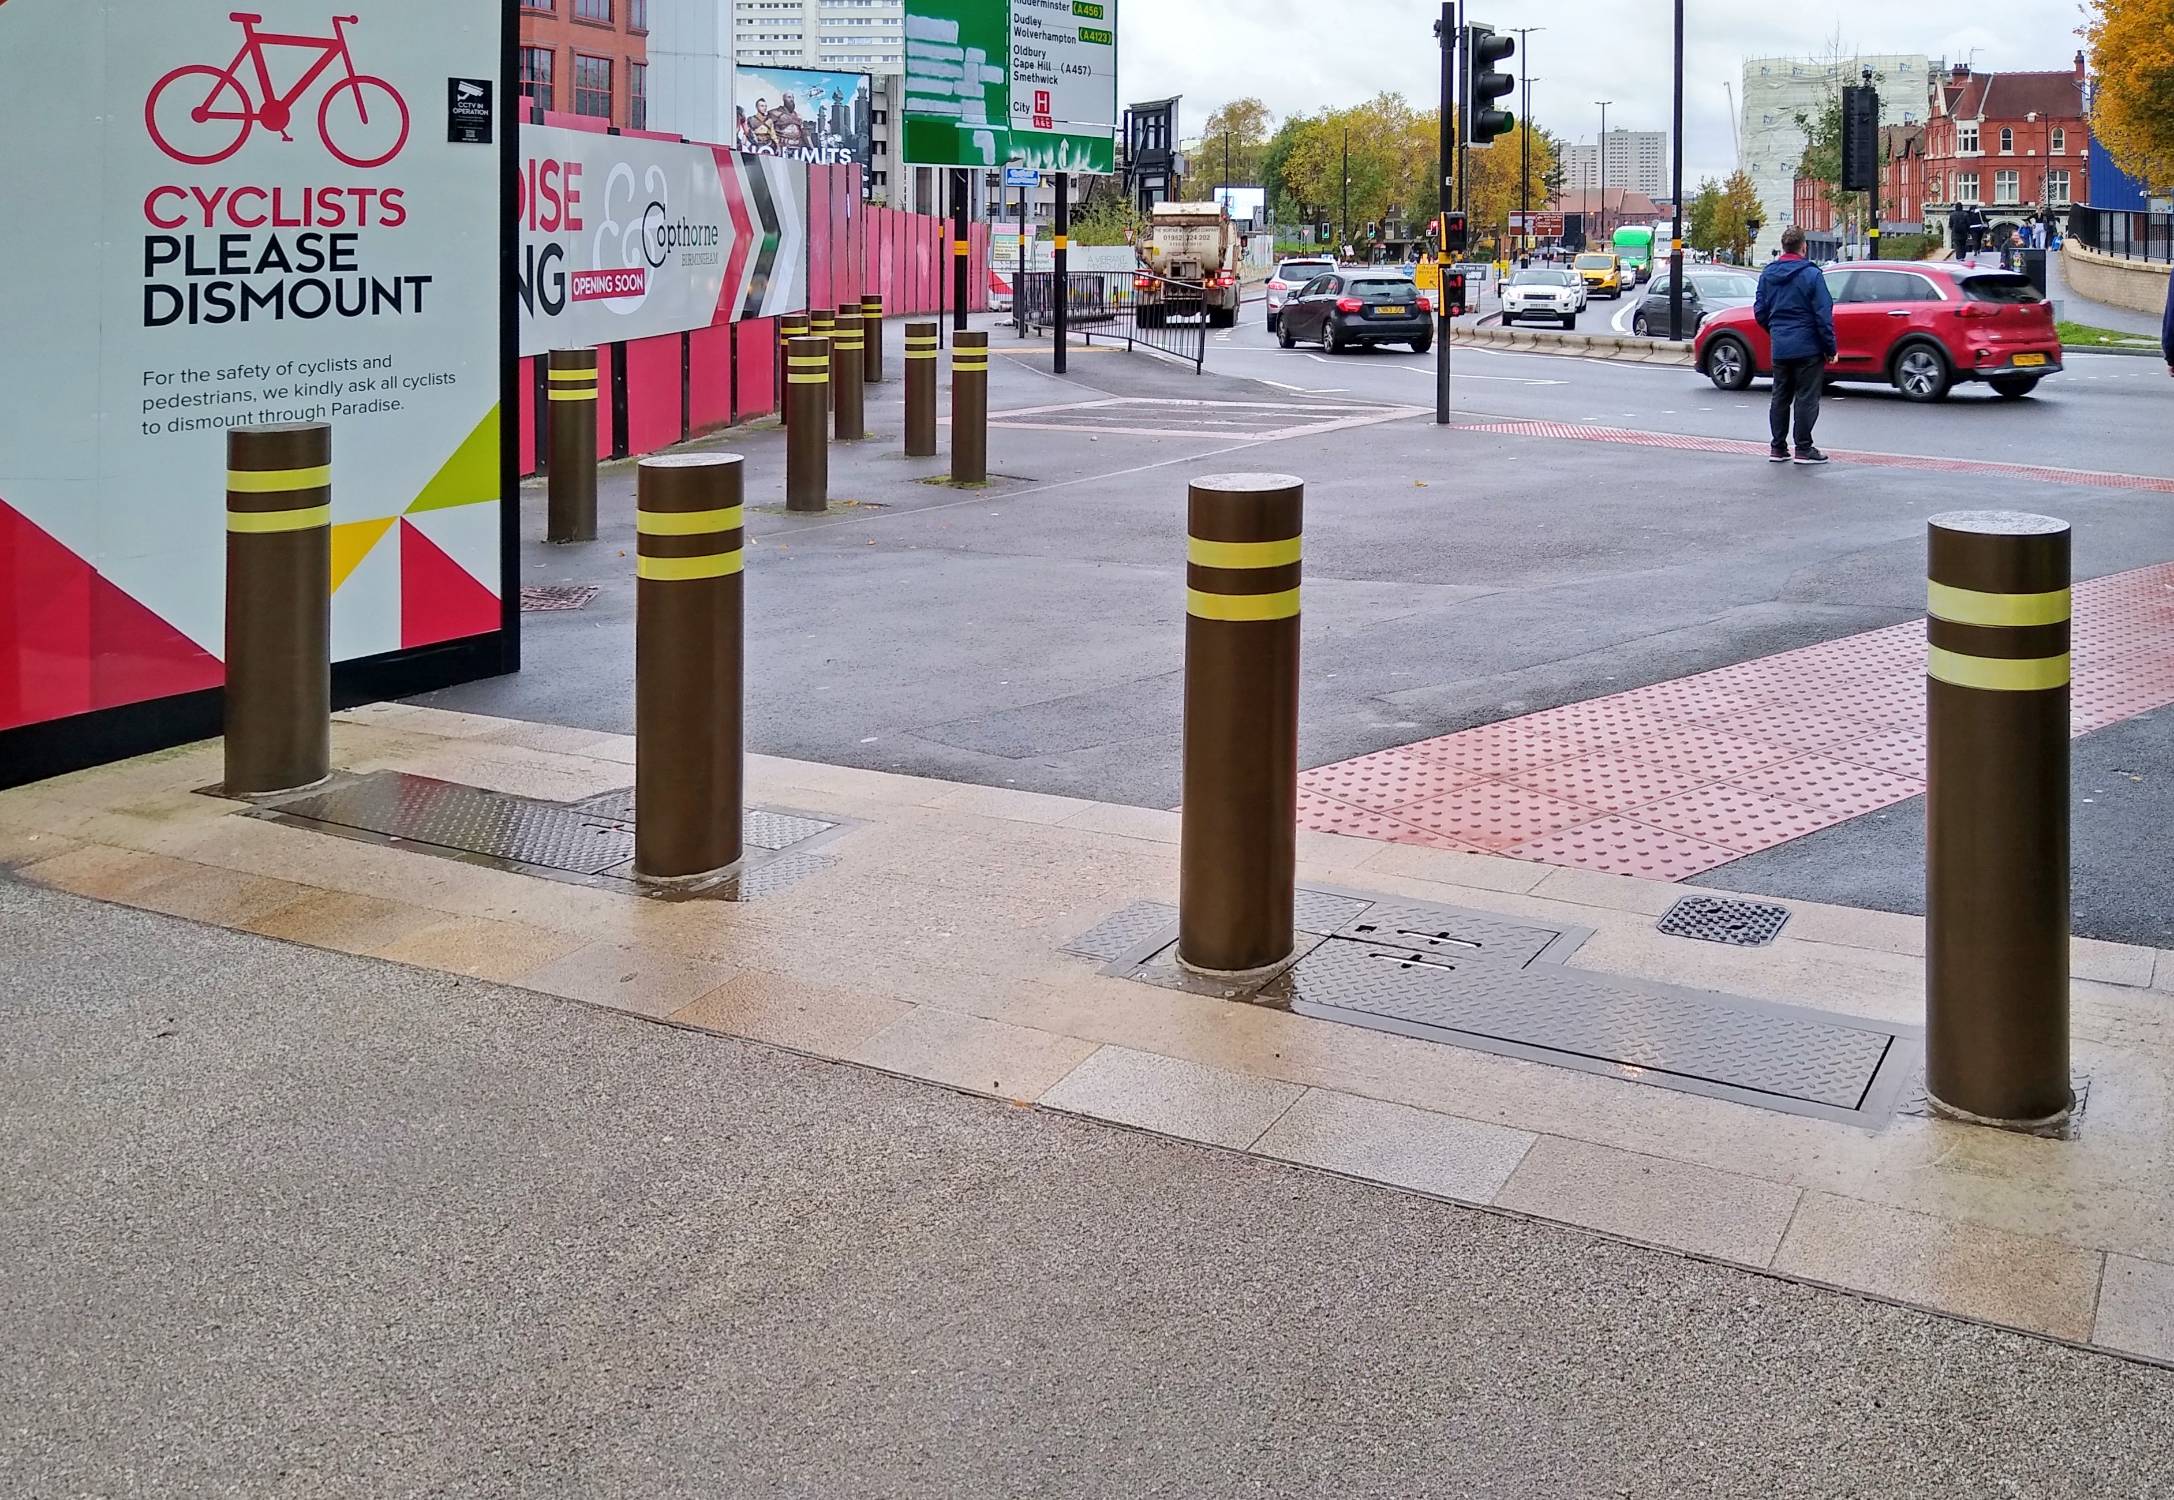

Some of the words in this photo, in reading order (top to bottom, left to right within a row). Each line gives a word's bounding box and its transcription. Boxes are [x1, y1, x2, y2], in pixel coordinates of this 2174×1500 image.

[1013, 0, 1070, 12] dderminster
[1073, 4, 1103, 18] (A456)
[1013, 13, 1042, 28] Dudley
[1013, 26, 1077, 45] Wolverhampton
[1079, 29, 1112, 44] (A4123)
[1013, 44, 1047, 60] Oldbury
[1013, 58, 1035, 71] Cape
[1037, 60, 1052, 71] Hill
[1060, 62, 1092, 77] (A457)
[1013, 71, 1059, 85] Smethwick
[452, 107, 488, 115] OPERATION
[1013, 101, 1031, 115] City
[782, 147, 852, 165] LIMITS
[143, 185, 407, 229] CYCLISTS
[642, 201, 719, 268] Copthorne
[144, 232, 359, 278] PLEASE
[573, 276, 613, 296] OPENING
[614, 273, 644, 292] SOON
[143, 275, 433, 327] DISMOUNT
[143, 371, 175, 386] For
[181, 369, 211, 384] the
[216, 364, 271, 381] safety
[276, 361, 294, 376] of
[298, 358, 358, 377] cyclists
[362, 354, 392, 369] and
[142, 390, 257, 414] pedestrians,
[263, 387, 289, 400] we
[294, 380, 344, 398] kindly
[348, 378, 376, 393] ask
[380, 375, 398, 390] all
[402, 372, 456, 391] cyclists
[141, 421, 161, 435] to
[167, 411, 253, 433] dismount
[258, 404, 326, 423] through
[331, 399, 405, 416] Paradise.
